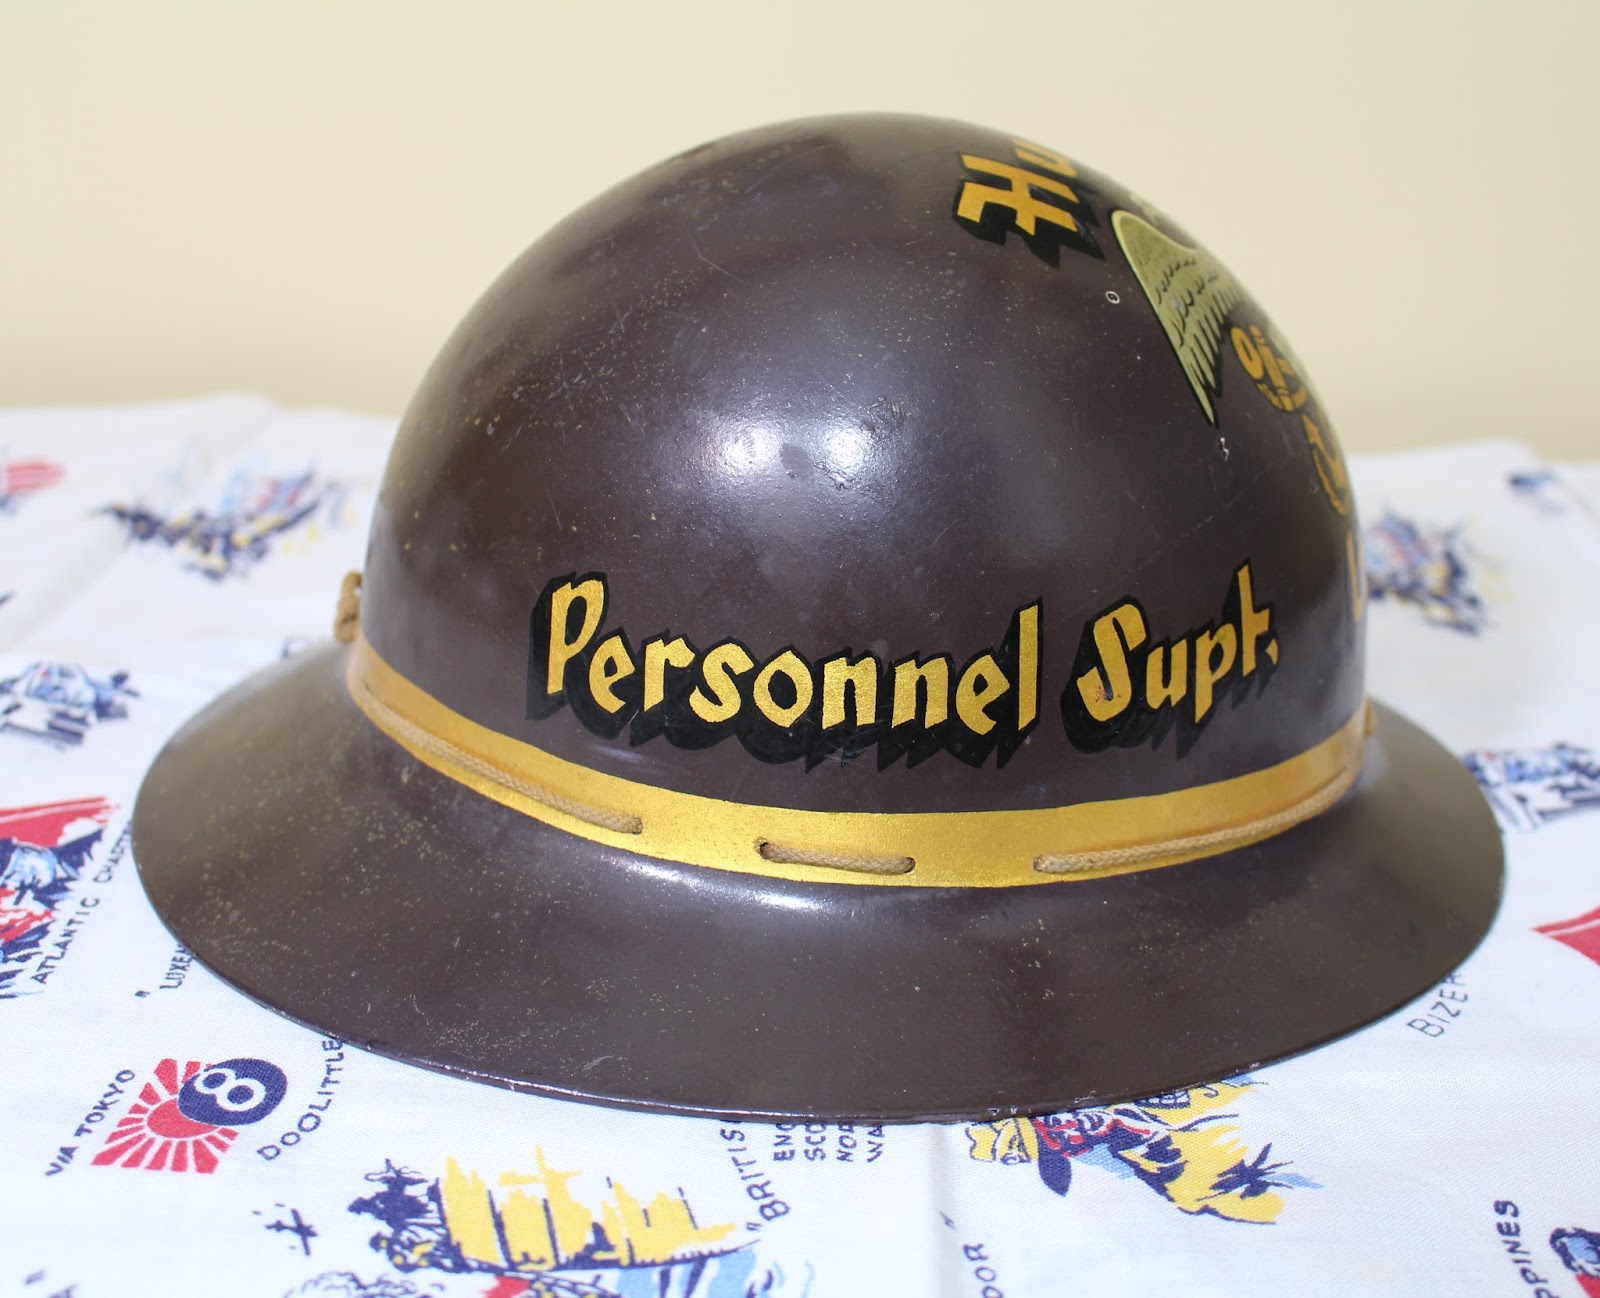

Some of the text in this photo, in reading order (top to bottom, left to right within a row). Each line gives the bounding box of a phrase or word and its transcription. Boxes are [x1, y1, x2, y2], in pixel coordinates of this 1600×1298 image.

[546, 579, 1041, 737] Personnel
[1074, 563, 1281, 725] Supt.
[30, 897, 101, 985] ATLANTIC
[45, 1069, 136, 1177] VIA TOKYO
[256, 1037, 345, 1161] DOOLITTLE
